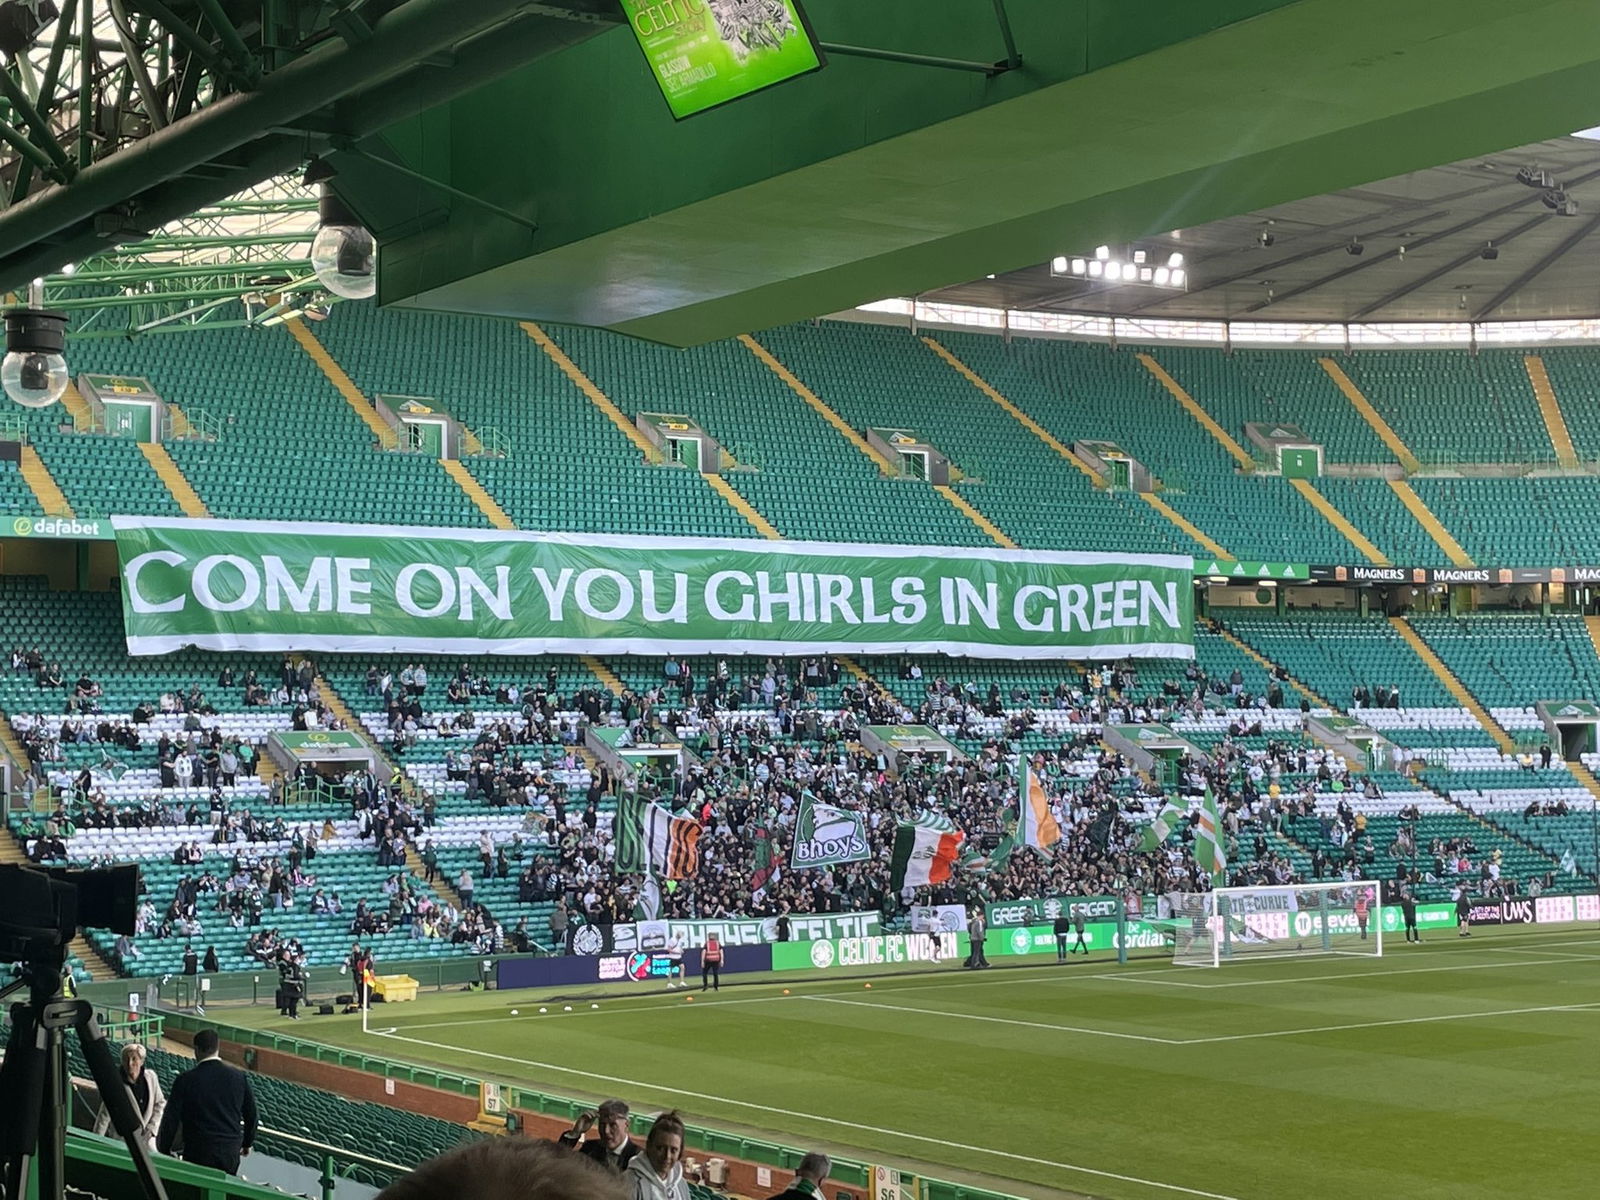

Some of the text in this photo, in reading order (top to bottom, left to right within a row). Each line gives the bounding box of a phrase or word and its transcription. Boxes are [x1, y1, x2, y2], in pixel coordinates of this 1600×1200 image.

[34, 518, 99, 536] dafabet
[1353, 567, 1405, 580] MAGNERS
[1433, 569, 1490, 581] MAGNERS
[124, 551, 1181, 632] COME ON YOU GHIRLS IN GREEN
[798, 836, 864, 859] Bhoys
[840, 937, 883, 965] CELTIC
[886, 934, 904, 962] FC
